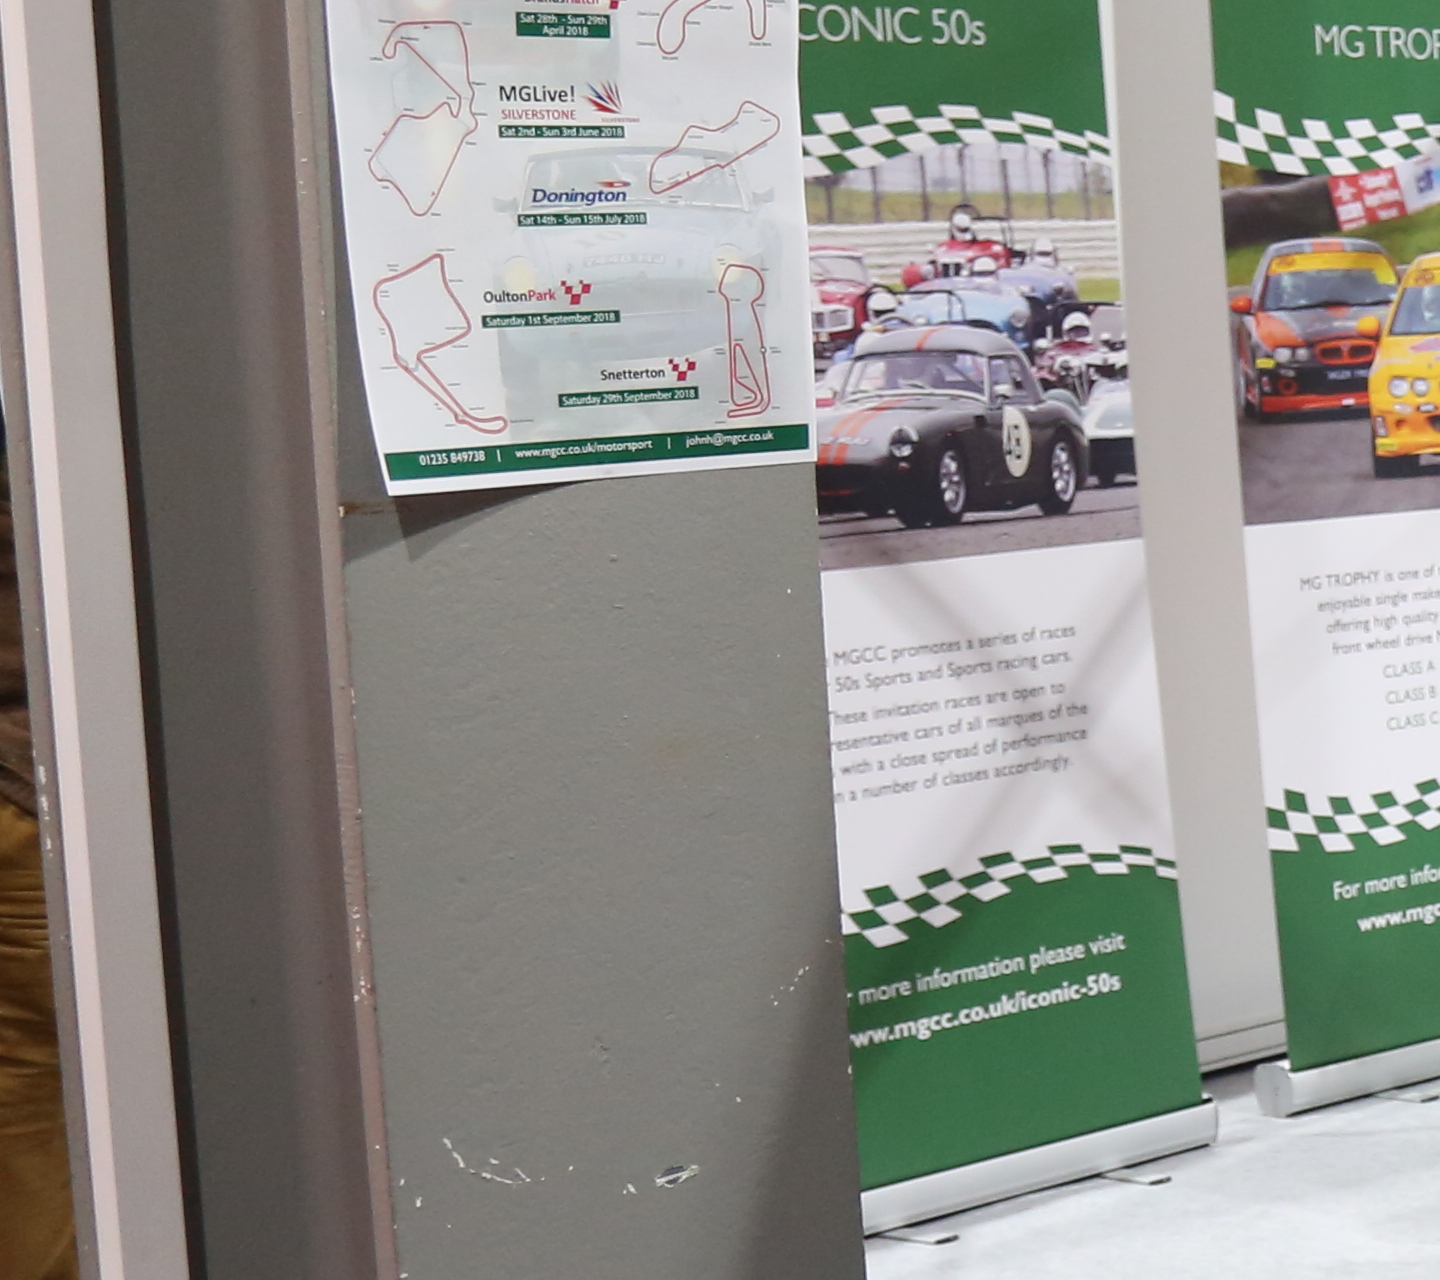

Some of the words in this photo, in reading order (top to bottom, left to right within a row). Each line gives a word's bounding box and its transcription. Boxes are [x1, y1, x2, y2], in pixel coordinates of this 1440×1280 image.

[520, 13, 535, 24] Sat
[538, 14, 558, 25] 28th
[567, 15, 583, 26] Sun
[586, 15, 608, 26] 29th
[797, 4, 921, 43] CONIC
[932, 10, 987, 46] 50s
[542, 23, 564, 37] April
[566, 24, 590, 36] 2018
[1314, 24, 1361, 56] MG
[499, 84, 575, 103] MGLive!
[501, 108, 577, 121] SILVERSTONE
[501, 126, 516, 138] Sat
[517, 126, 536, 138] 2nd
[543, 127, 560, 138] Sun
[562, 127, 578, 138] 3rd
[579, 126, 600, 137] June
[601, 126, 623, 137] 2018
[531, 188, 627, 206] Donington
[520, 215, 534, 226] Sat
[539, 214, 557, 225] 14th
[564, 215, 581, 225] Sun
[584, 214, 603, 225] 15th
[605, 214, 622, 227] July
[624, 213, 646, 224] 2018
[483, 288, 556, 304] OultonPark
[486, 316, 526, 330] Saturday
[529, 315, 543, 327] 1st
[545, 313, 592, 329] September
[593, 312, 616, 324] 2018
[601, 367, 665, 381] Snetterton
[562, 393, 600, 407] Saturday
[602, 392, 622, 404] 29th
[623, 389, 672, 404] September
[674, 389, 695, 401] 2018
[418, 453, 448, 466] 01235
[450, 451, 485, 464] 849738
[515, 439, 653, 459] www.mgcc.co.uk/motorsport
[685, 431, 774, 449] johnh@mgcc.co.uk
[1333, 879, 1361, 901] For
[1364, 874, 1408, 895] more
[858, 979, 911, 1005] more
[916, 956, 1025, 993] information
[1029, 943, 1085, 974] please
[1089, 932, 1126, 956] visit
[850, 972, 1121, 1048] ww.mgcc.co.uk/iconic-50s
